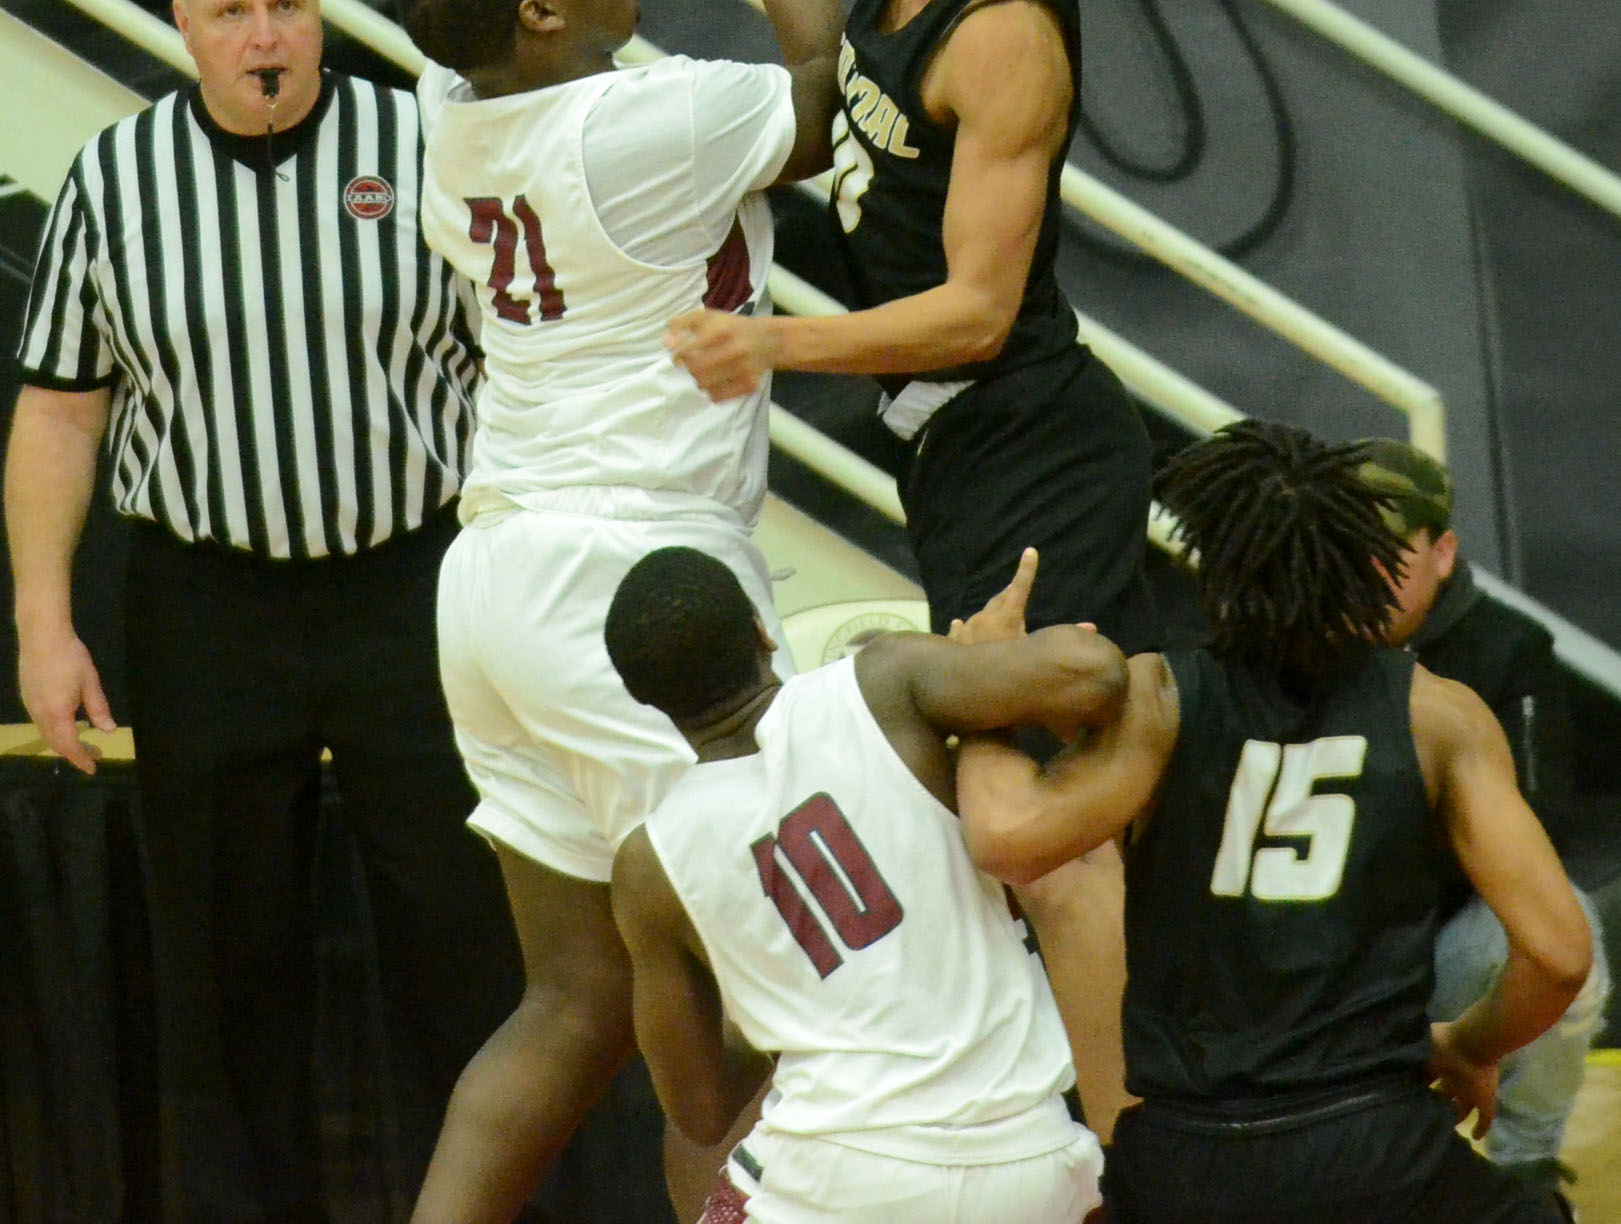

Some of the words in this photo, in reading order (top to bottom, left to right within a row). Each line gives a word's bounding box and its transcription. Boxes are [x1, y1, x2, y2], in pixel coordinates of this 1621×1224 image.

[462, 192, 568, 326] 21
[749, 791, 904, 981] 10
[1210, 735, 1367, 901] 15
